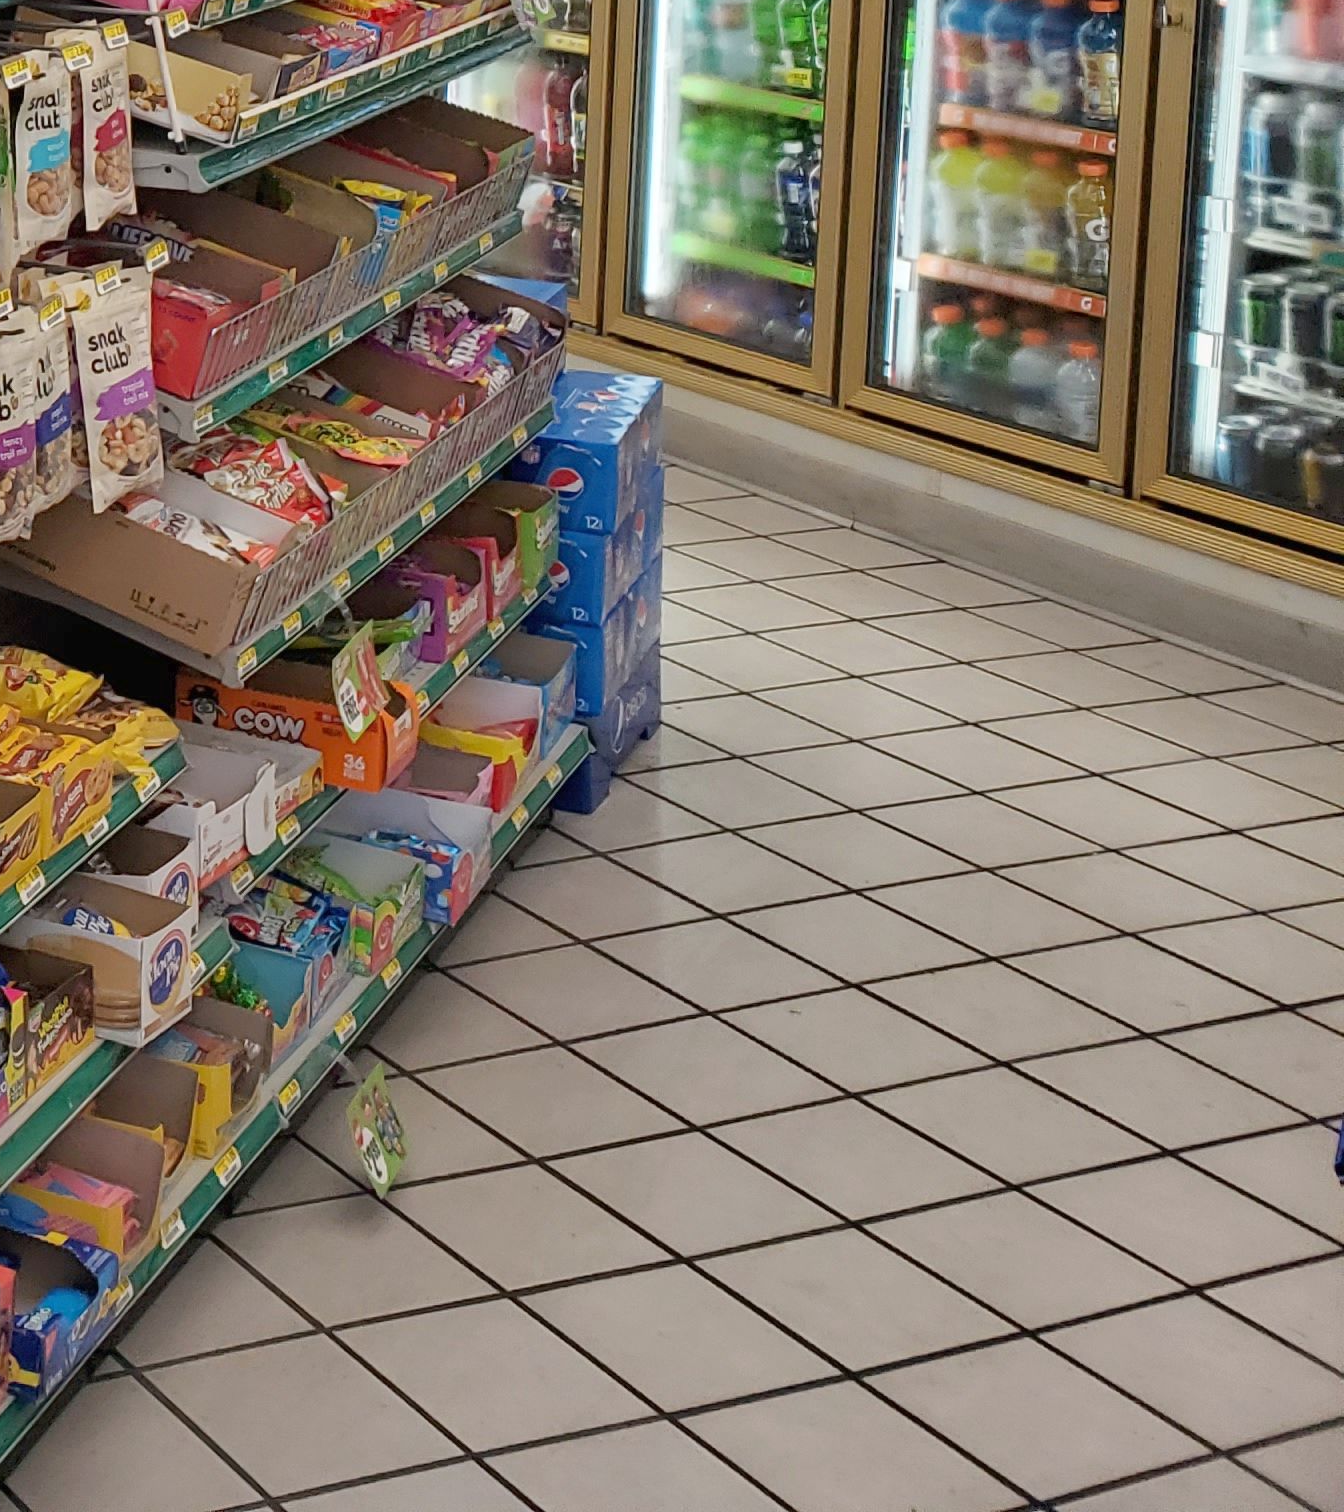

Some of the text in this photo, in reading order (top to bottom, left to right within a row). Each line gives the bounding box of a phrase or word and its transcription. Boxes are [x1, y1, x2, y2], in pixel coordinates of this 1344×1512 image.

[88, 322, 127, 351] snak
[91, 350, 129, 374] club
[585, 516, 598, 528] 12
[233, 706, 305, 739] COW
[343, 753, 365, 770] 36
